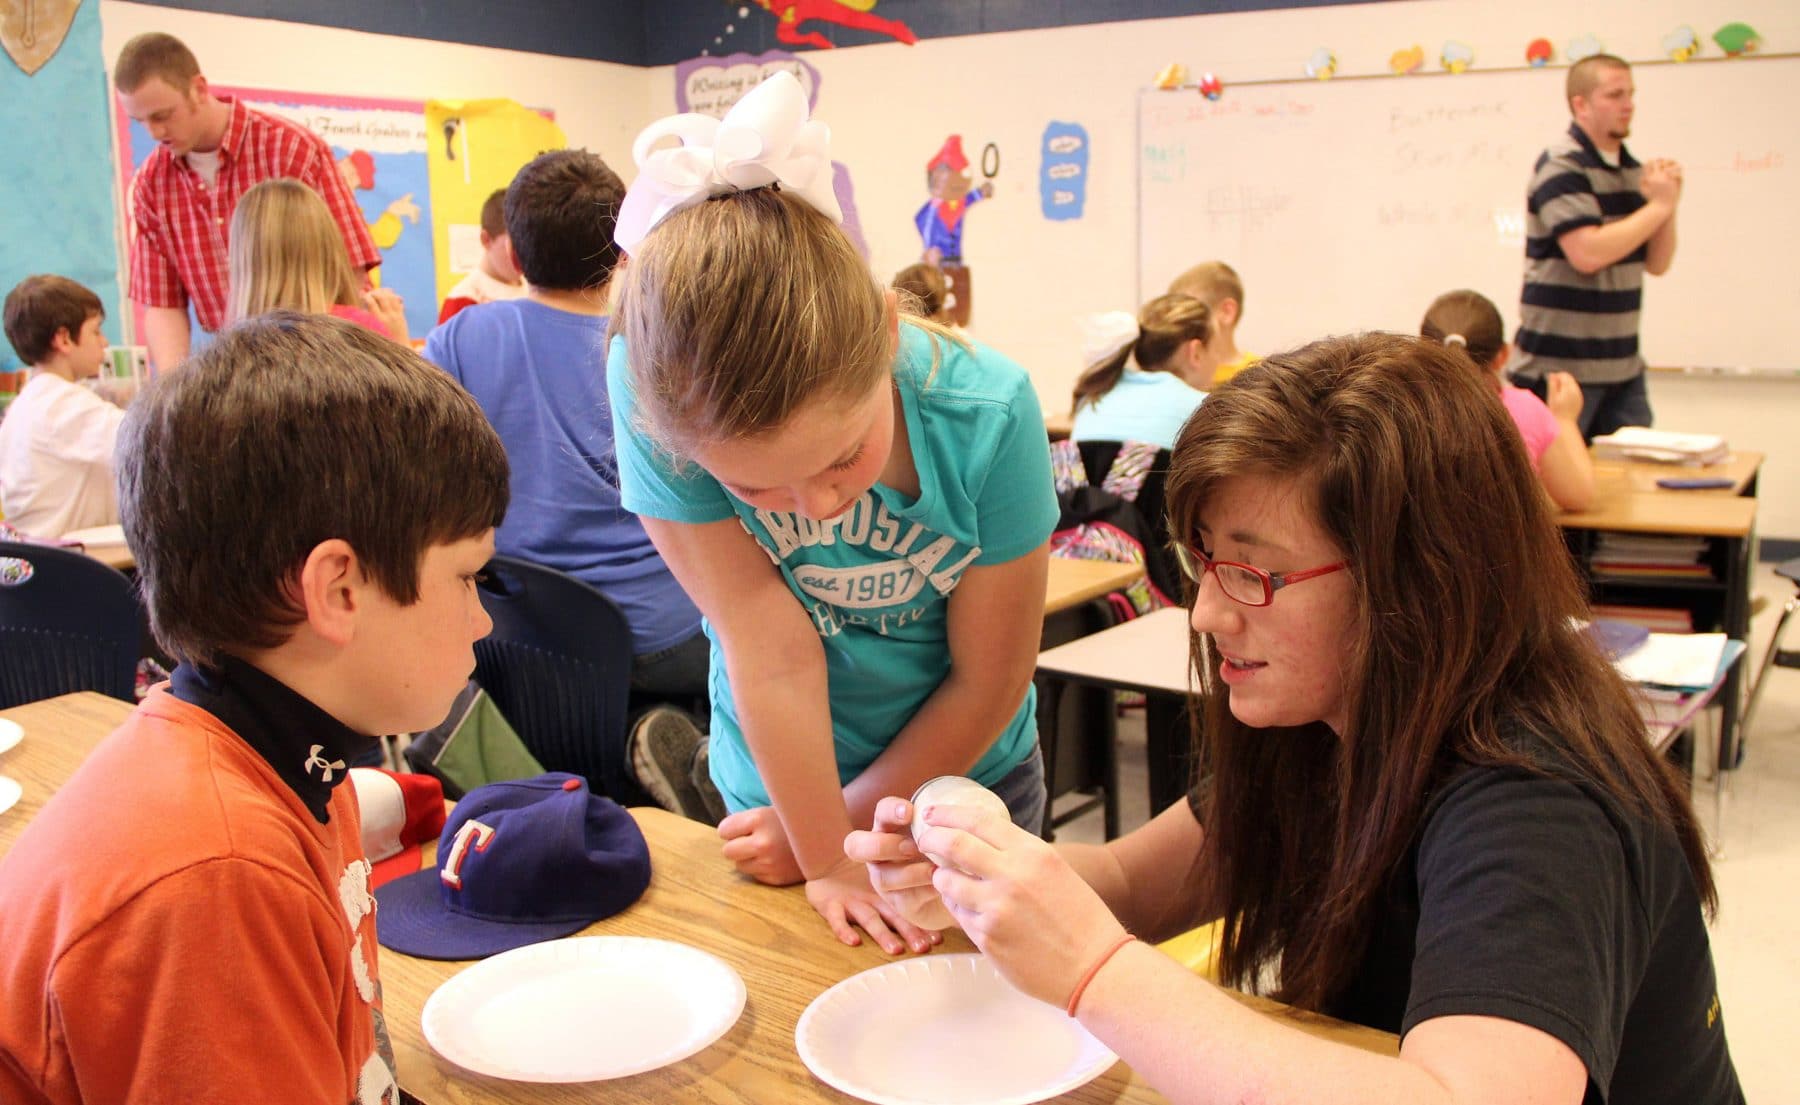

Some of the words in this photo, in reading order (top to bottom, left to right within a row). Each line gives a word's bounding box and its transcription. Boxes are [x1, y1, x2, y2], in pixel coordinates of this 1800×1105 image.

[802, 575, 839, 592] est.
[846, 567, 914, 602] 1987
[440, 819, 496, 891] T
